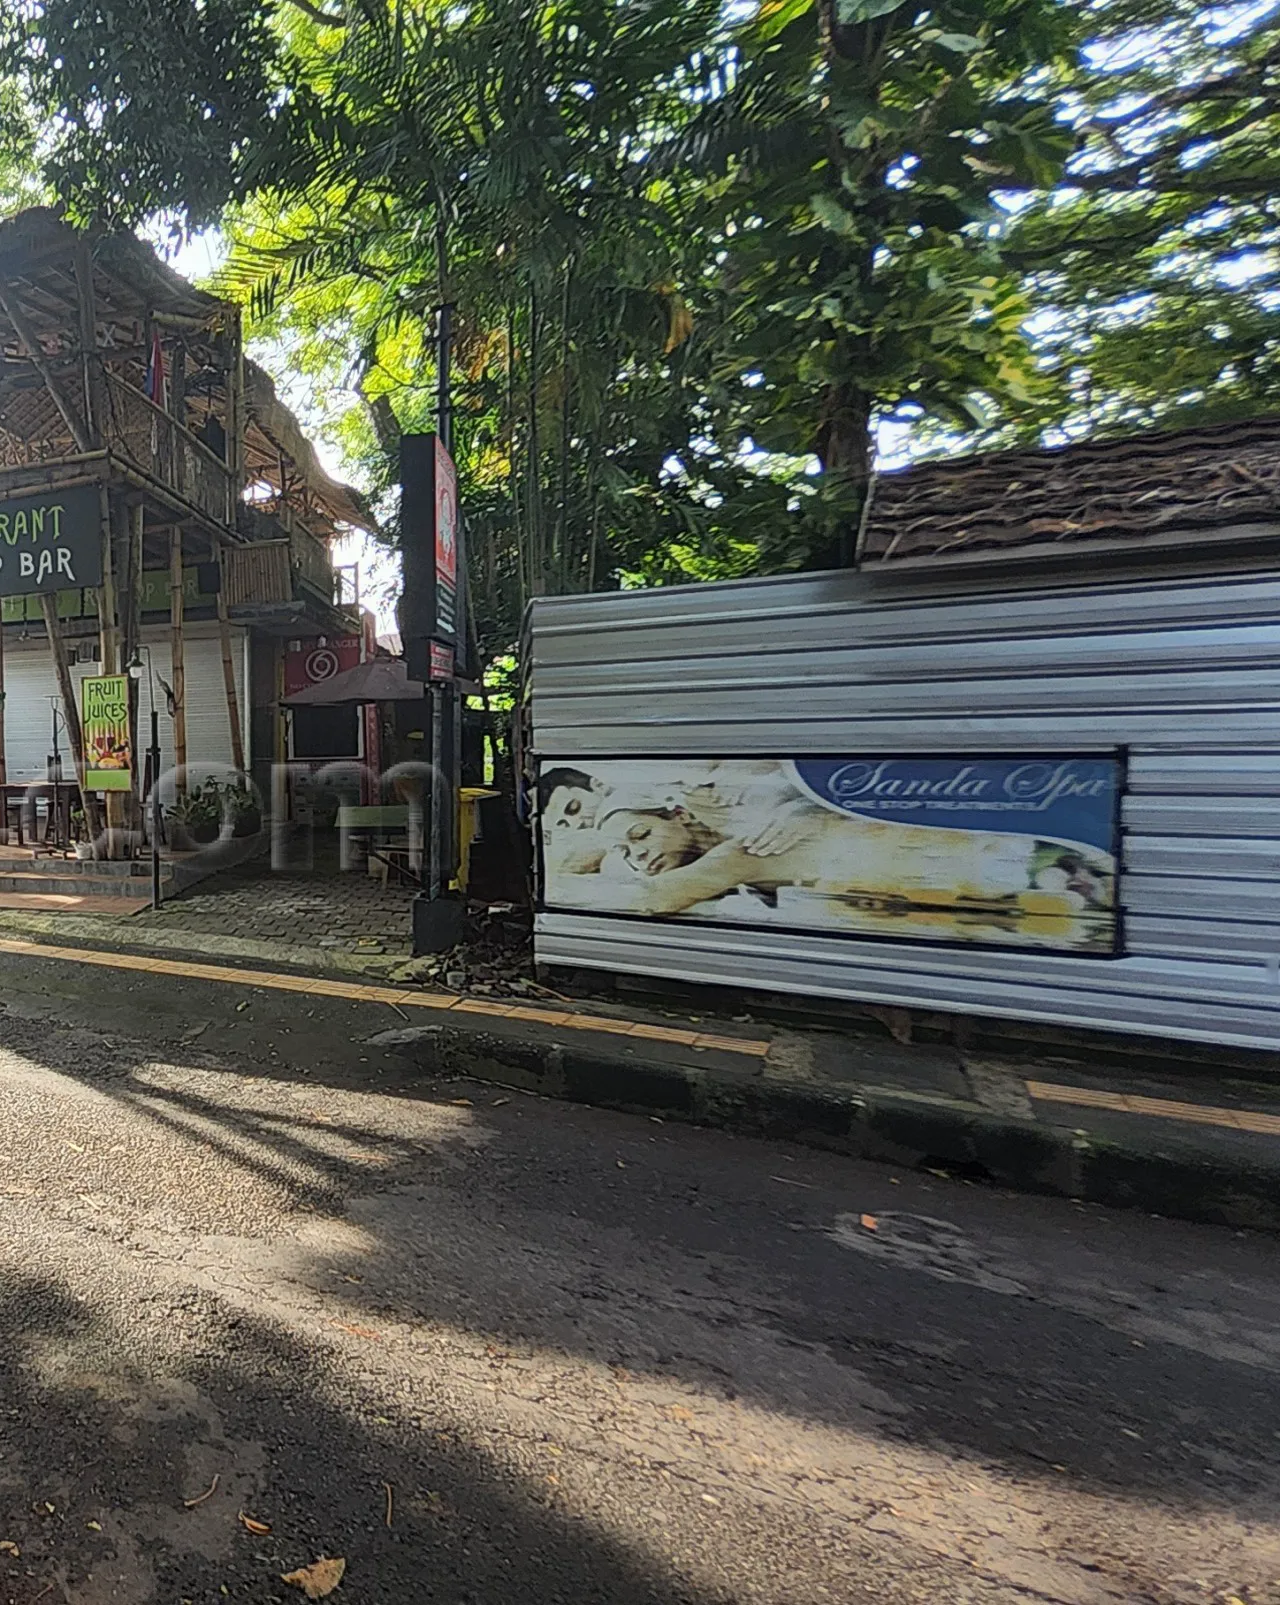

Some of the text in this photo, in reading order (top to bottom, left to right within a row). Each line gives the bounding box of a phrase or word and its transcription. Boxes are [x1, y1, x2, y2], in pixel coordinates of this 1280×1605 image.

[19, 547, 76, 585] BAR
[88, 680, 122, 702] FRUIT
[84, 702, 127, 725] JUICES
[827, 760, 1109, 812] Sanda Spa
[842, 799, 877, 810] ONE
[880, 800, 920, 810] STOP
